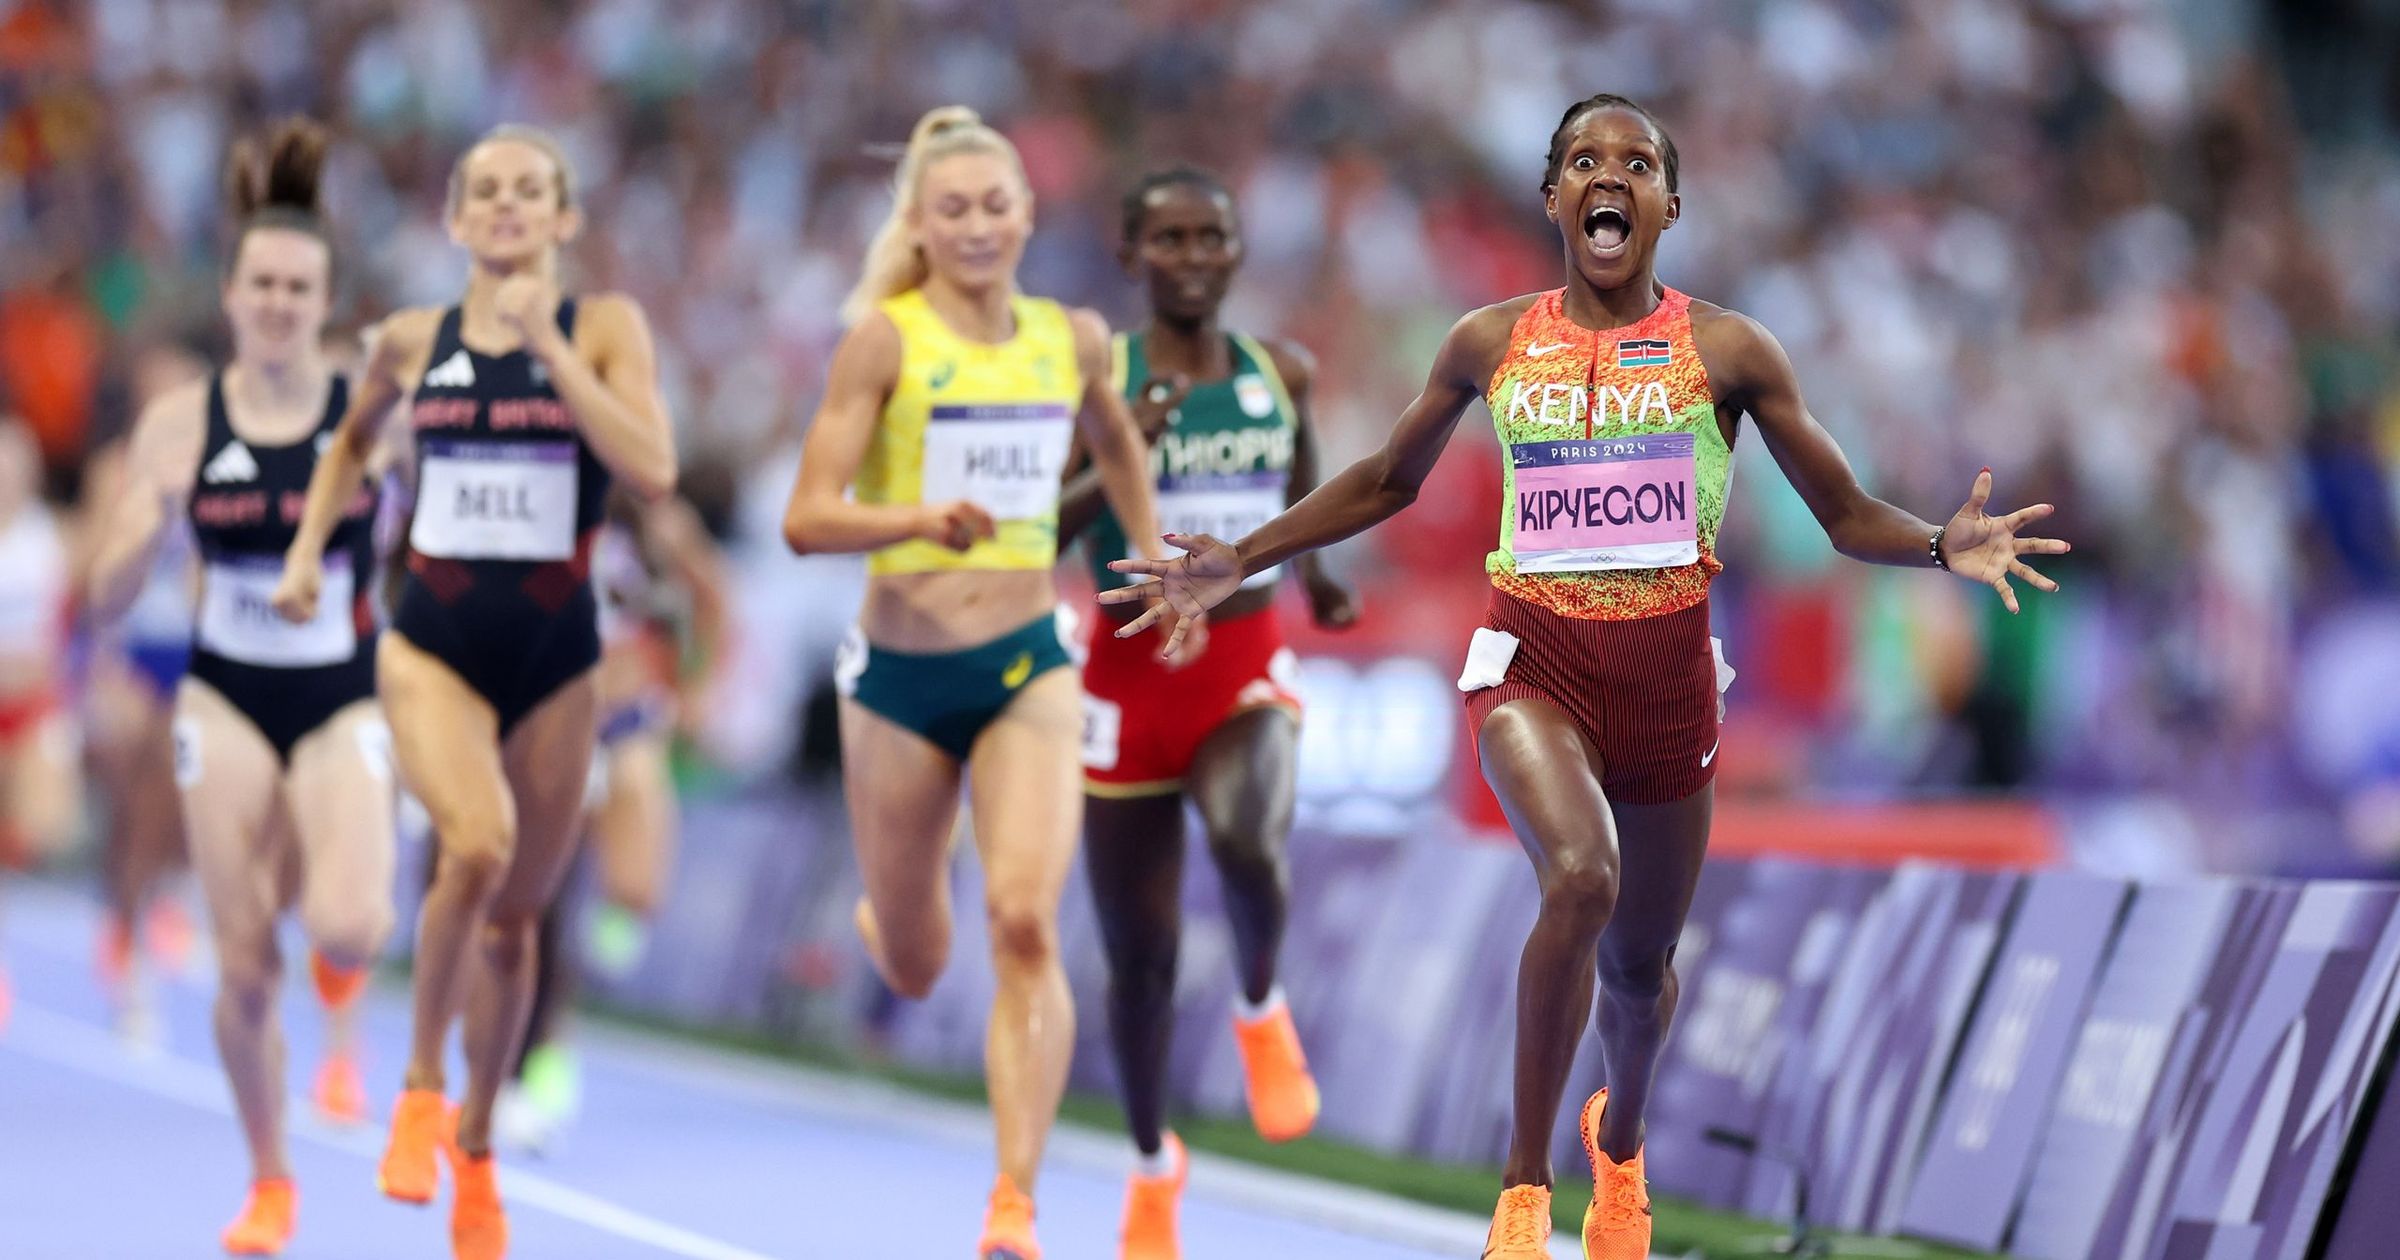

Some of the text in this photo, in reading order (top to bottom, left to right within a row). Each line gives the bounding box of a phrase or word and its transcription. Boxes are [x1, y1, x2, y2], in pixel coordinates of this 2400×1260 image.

[1508, 381, 1674, 427] KENYA
[964, 443, 1045, 480] HULL
[1551, 442, 1646, 459] PARIS 2024
[1520, 480, 1686, 532] KIPYEGON
